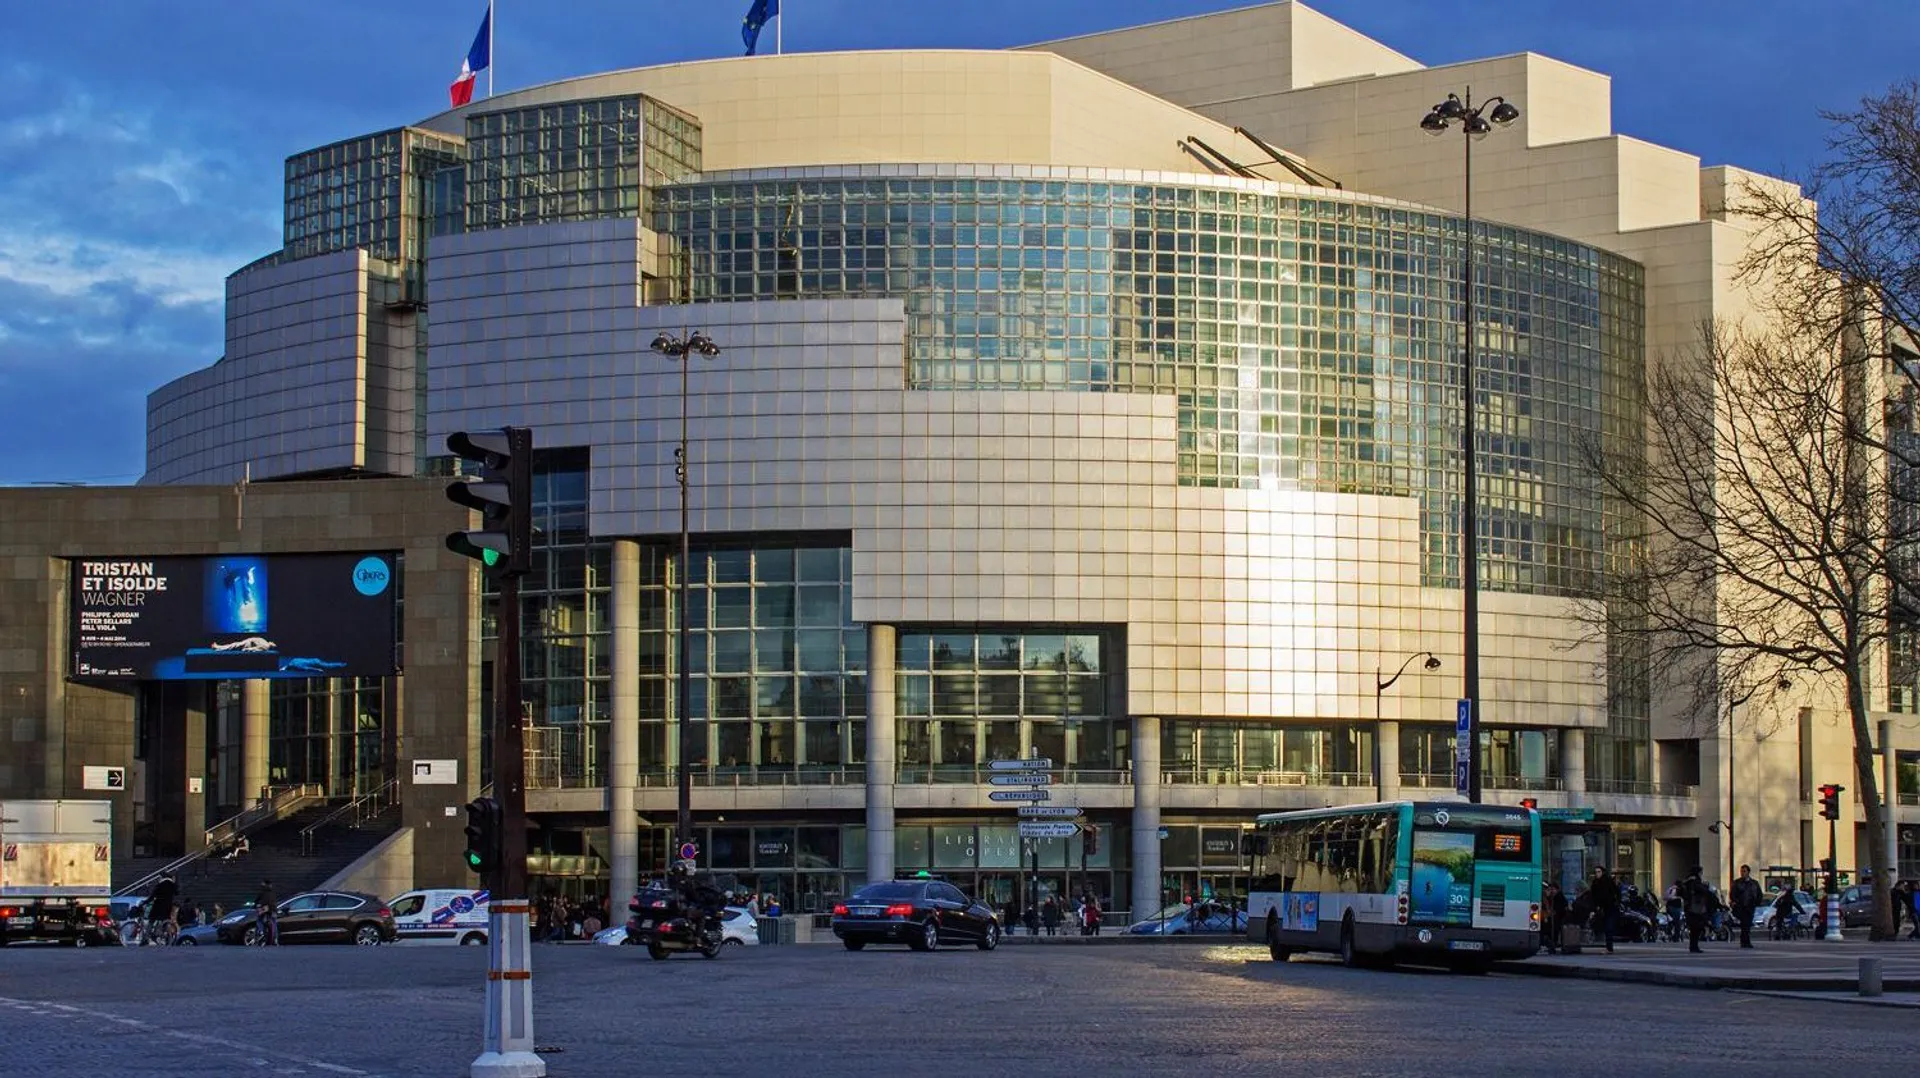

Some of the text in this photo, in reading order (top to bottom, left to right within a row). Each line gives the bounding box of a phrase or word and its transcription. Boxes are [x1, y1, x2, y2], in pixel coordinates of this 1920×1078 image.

[82, 562, 153, 576] TRISTAN
[82, 577, 167, 590] ET ISOLDE
[82, 592, 145, 606] WAGNER
[1460, 706, 1466, 726] P
[1459, 766, 1465, 787] P
